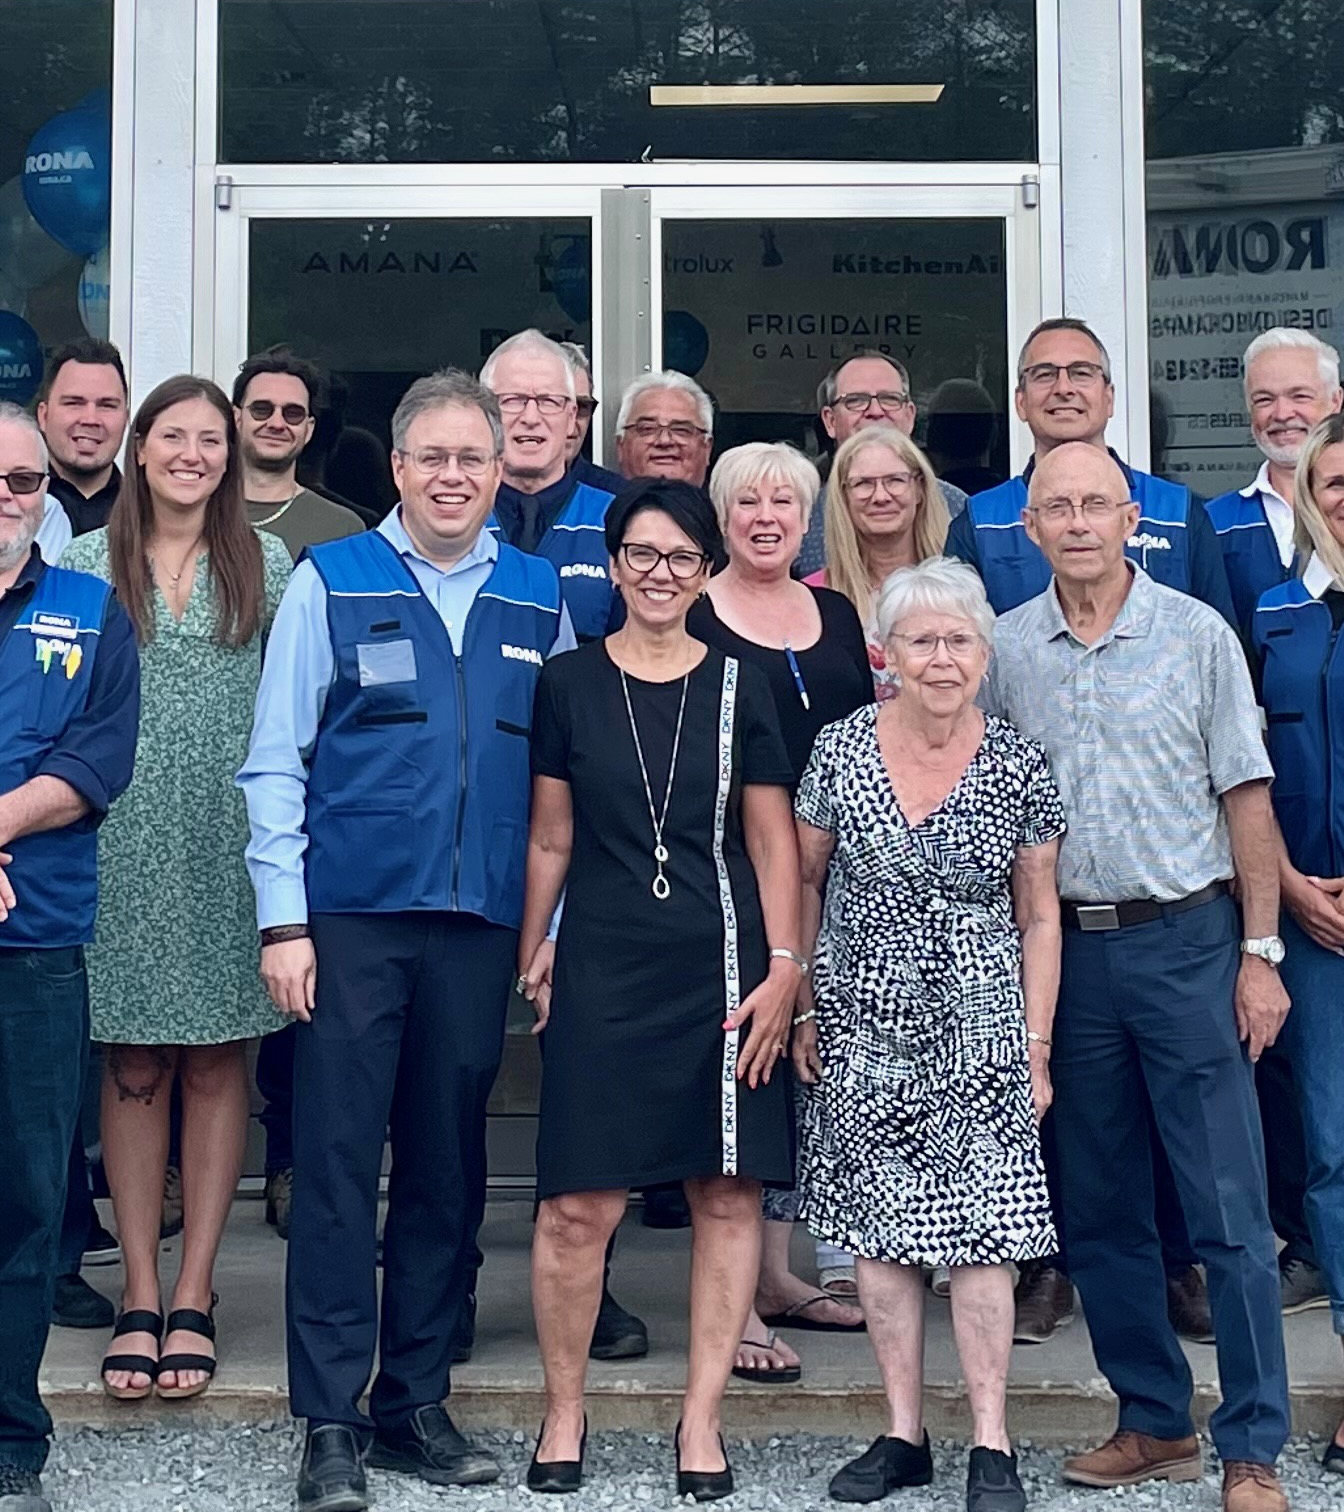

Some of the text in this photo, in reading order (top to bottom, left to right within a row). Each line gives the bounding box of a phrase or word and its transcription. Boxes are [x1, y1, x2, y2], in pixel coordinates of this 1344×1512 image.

[25, 151, 94, 174] RONA
[302, 251, 479, 274] AMANA
[832, 253, 999, 275] KitchenAi
[747, 314, 923, 336] FRIGIDAIRE
[560, 563, 607, 579] RONA
[725, 660, 736, 691] DKNY
[721, 698, 733, 734] DKNY
[721, 741, 731, 781] DKNY
[721, 889, 736, 930] DKNY
[726, 939, 737, 981] DKNY
[728, 990, 737, 1011] NY
[724, 1041, 737, 1082] DKNY
[724, 1091, 734, 1133] DKNY
[724, 1142, 736, 1176] KNY
